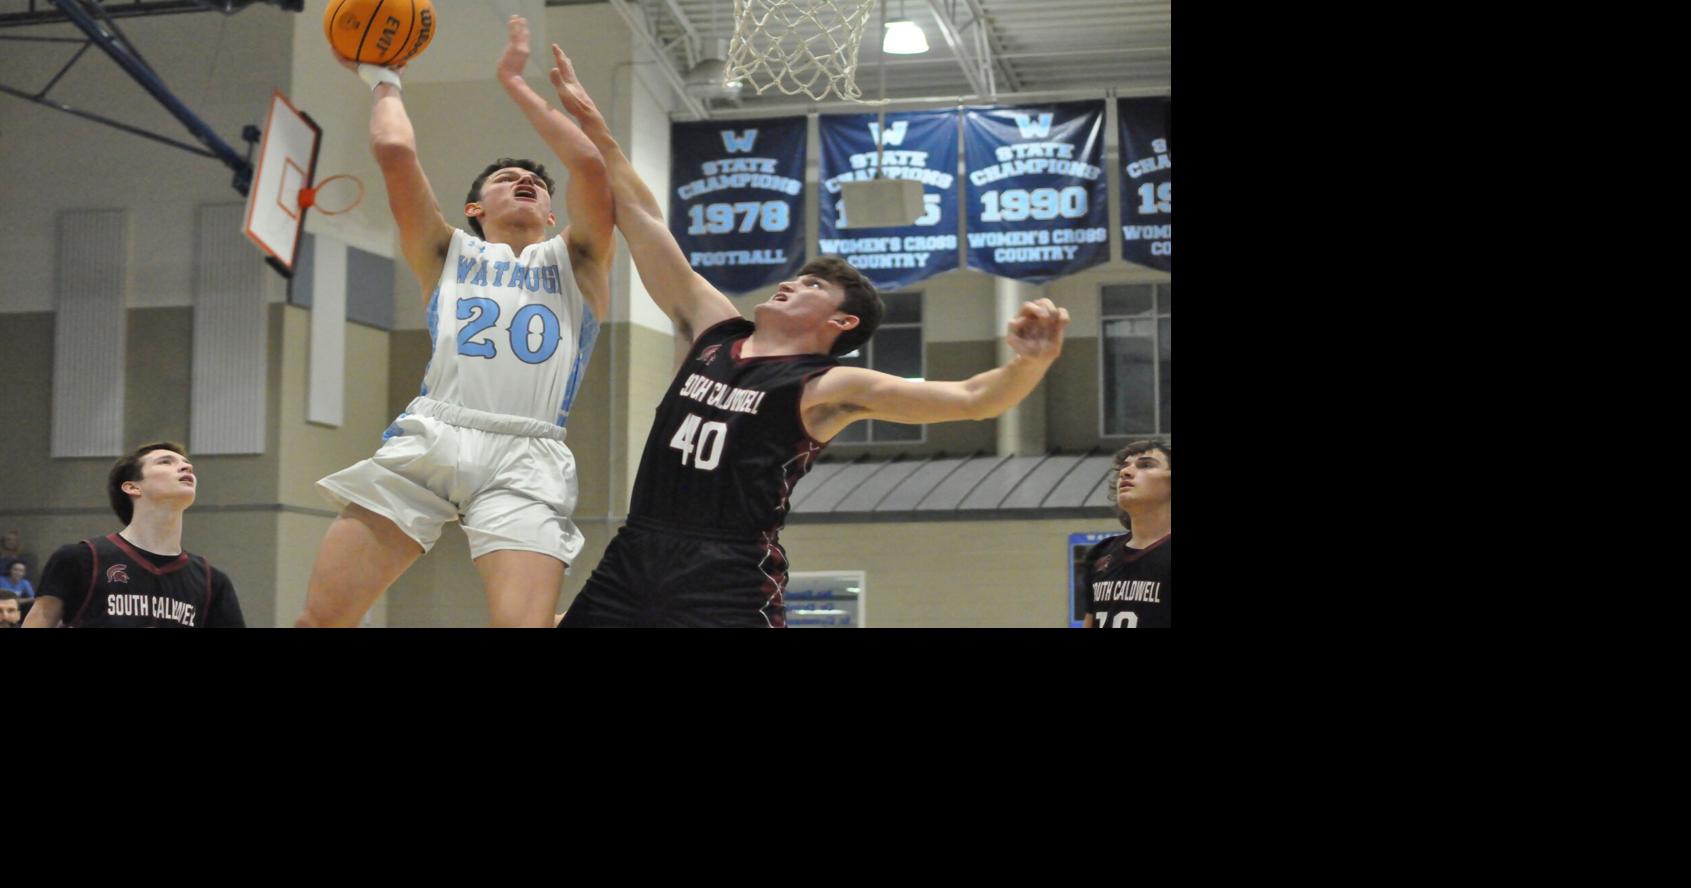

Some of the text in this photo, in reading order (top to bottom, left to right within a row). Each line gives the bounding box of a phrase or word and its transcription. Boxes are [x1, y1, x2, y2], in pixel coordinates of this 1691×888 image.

[1015, 113, 1054, 139] W
[721, 129, 759, 153] W
[995, 143, 1075, 161] STATE
[702, 158, 778, 176] STATE
[970, 158, 1101, 187] CHAMPIONS
[677, 173, 802, 200] CHAMPIONS
[834, 193, 942, 230] 15
[980, 186, 1089, 222] 1990
[687, 200, 790, 235] 1978
[818, 234, 957, 254] WOMEN'S CROSS
[967, 227, 1107, 249] WOMEN'S CROSS
[690, 249, 787, 267] FOOTBALL
[847, 252, 930, 270] COUNTRY
[994, 245, 1078, 264] COUNTRY
[456, 296, 563, 365] 20
[669, 412, 727, 471] 40
[1113, 580, 1161, 604] CALDWELL
[107, 594, 149, 617] SOUTH
